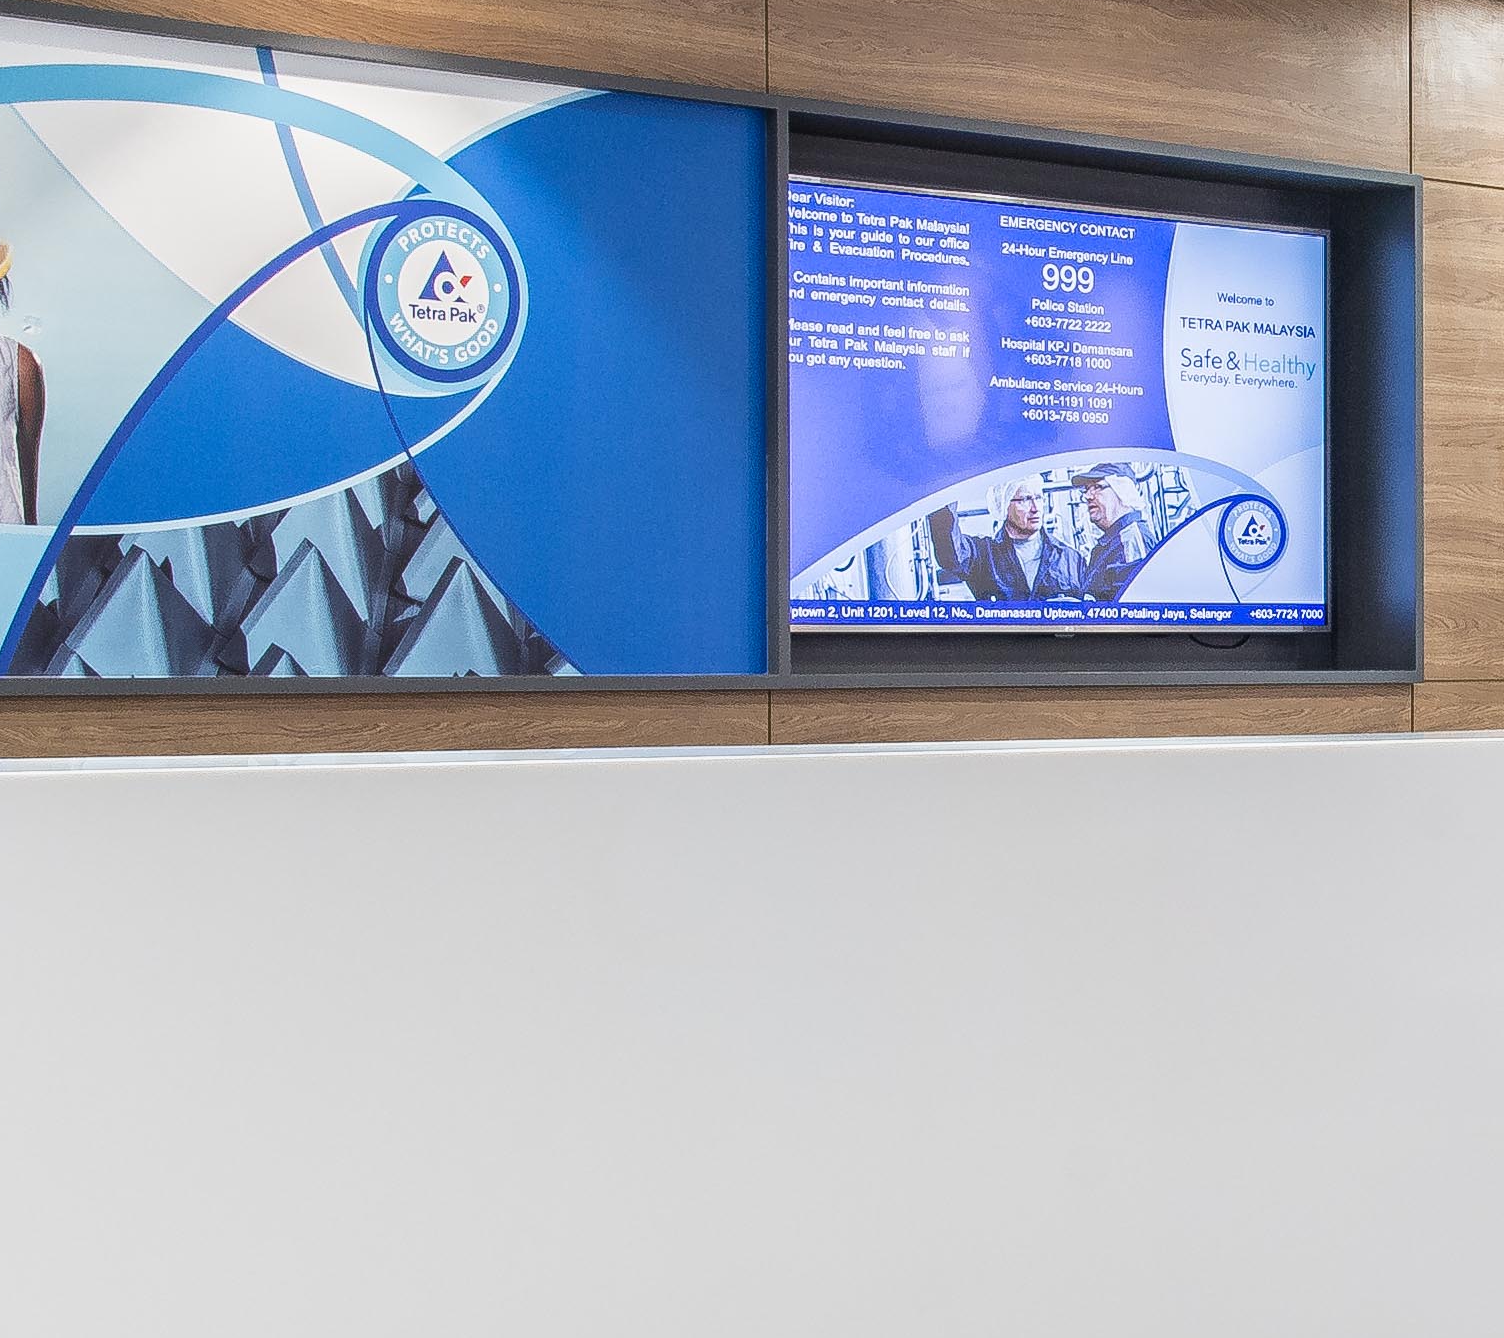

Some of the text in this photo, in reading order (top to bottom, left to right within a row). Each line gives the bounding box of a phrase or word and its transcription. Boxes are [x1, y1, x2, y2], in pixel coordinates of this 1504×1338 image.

[841, 213, 853, 224] to
[856, 212, 886, 227] Tetra
[890, 216, 913, 230] Pak
[1000, 215, 1136, 239] EMERGENCY CONTACT
[397, 220, 490, 259] PROTECTS
[813, 224, 824, 237] is
[829, 227, 855, 241] your
[861, 230, 893, 244] guide
[898, 233, 910, 245] to
[915, 235, 934, 247] our
[939, 237, 970, 251] office
[788, 238, 971, 267] ire & Evacuation Procedures.
[1001, 243, 1133, 265] 24-Hour Emergency Line
[793, 270, 970, 297] Contains important information
[1042, 263, 1094, 293] 999
[788, 287, 971, 312] nd emergency contact details.
[1031, 298, 1105, 315] Police Station
[1217, 292, 1275, 306] Welcome to
[408, 304, 446, 322] Tetra
[788, 317, 970, 343] lease read and feel free to ask
[1025, 316, 1112, 332] +603-7722 2222
[1180, 317, 1316, 338] TETRA PAK MALAYSIA
[389, 312, 499, 365] WHAT'S GOOD
[788, 336, 971, 358] ur Tetra Pak Malaysia staff if
[1001, 337, 1133, 357] Hospital KPJ Damansara
[788, 353, 906, 370] ou got any question.
[1024, 354, 1112, 369] +603-7718 1000
[1181, 348, 1317, 381] Safe & Healthy
[990, 376, 1144, 396] Ambulance Service 24-Hours
[1180, 371, 1298, 389] Everyday. Everywhere.
[1022, 394, 1113, 409] +6011-1191 1091
[1022, 409, 1109, 424] +6013-758 0950
[791, 606, 825, 619] ptown
[827, 606, 839, 619] 2,
[841, 606, 865, 618] Unit
[867, 606, 898, 619] 1201,
[900, 606, 930, 618] Level
[932, 606, 949, 619] 12,
[1044, 607, 1085, 621] Uptown,
[1087, 608, 1118, 619] 47400
[1121, 607, 1160, 621] Petaling
[1162, 608, 1188, 621] Jaya,
[1190, 608, 1233, 621] Selangor
[1250, 608, 1299, 620] +603-7724
[1301, 608, 1324, 619] 7000
